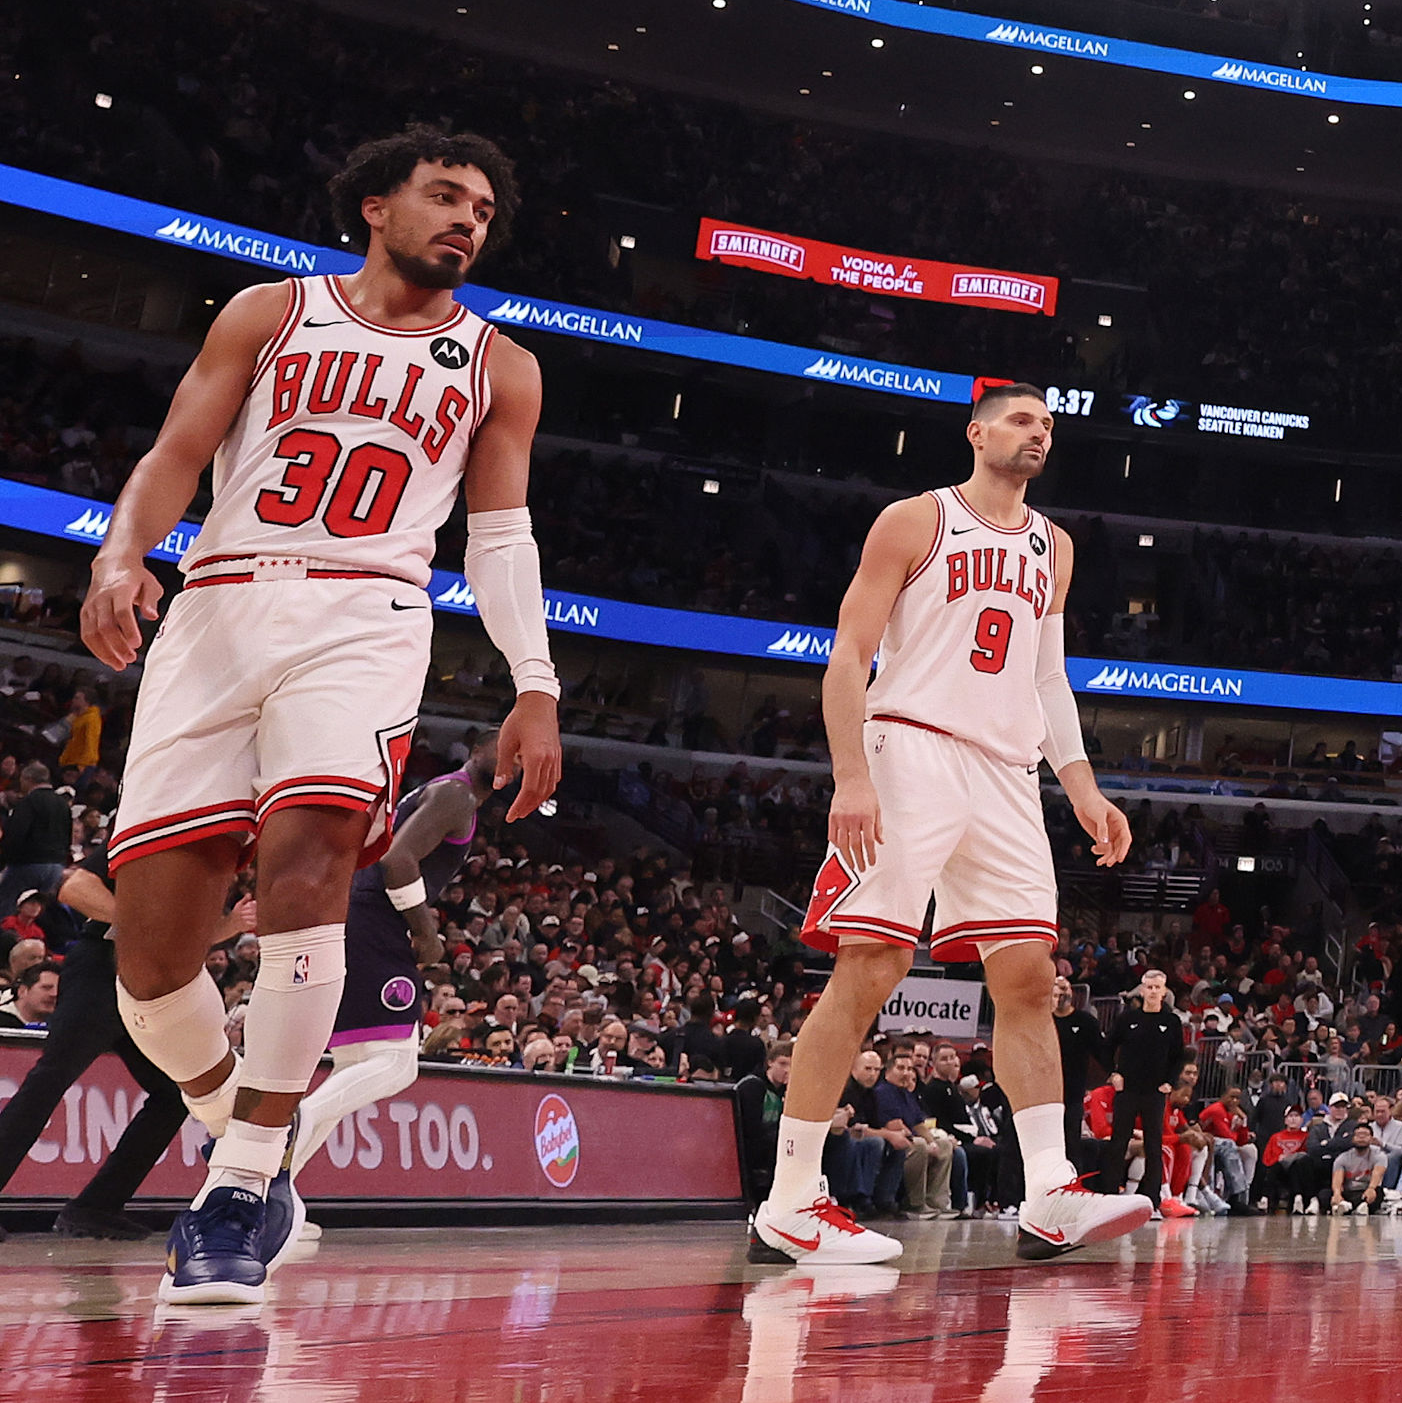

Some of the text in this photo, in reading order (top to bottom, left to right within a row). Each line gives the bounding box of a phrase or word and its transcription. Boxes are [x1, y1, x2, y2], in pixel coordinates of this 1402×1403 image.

[1019, 28, 1109, 57] MAGELLAN
[1241, 67, 1327, 94] MAGELLAN
[198, 226, 317, 273] MAGELLAN
[716, 234, 800, 266] SMIRNOFF
[830, 266, 924, 295] THE PEOPLE
[842, 254, 918, 281] VODKA for
[957, 275, 1040, 304] SMIRNOFF
[528, 306, 642, 343] MAGELLAN
[840, 363, 941, 397] MAGELLAN
[265, 350, 470, 465] BULLS
[1200, 404, 1310, 430] VANCOUVER CANUCKS
[1198, 418, 1285, 440] SEATTLE KRAKEN
[254, 427, 413, 540] 30
[946, 547, 1048, 620] BULLS
[970, 606, 1013, 675] 9
[1128, 670, 1242, 698] MAGELLAN
[326, 1101, 494, 1173] US TOO.
